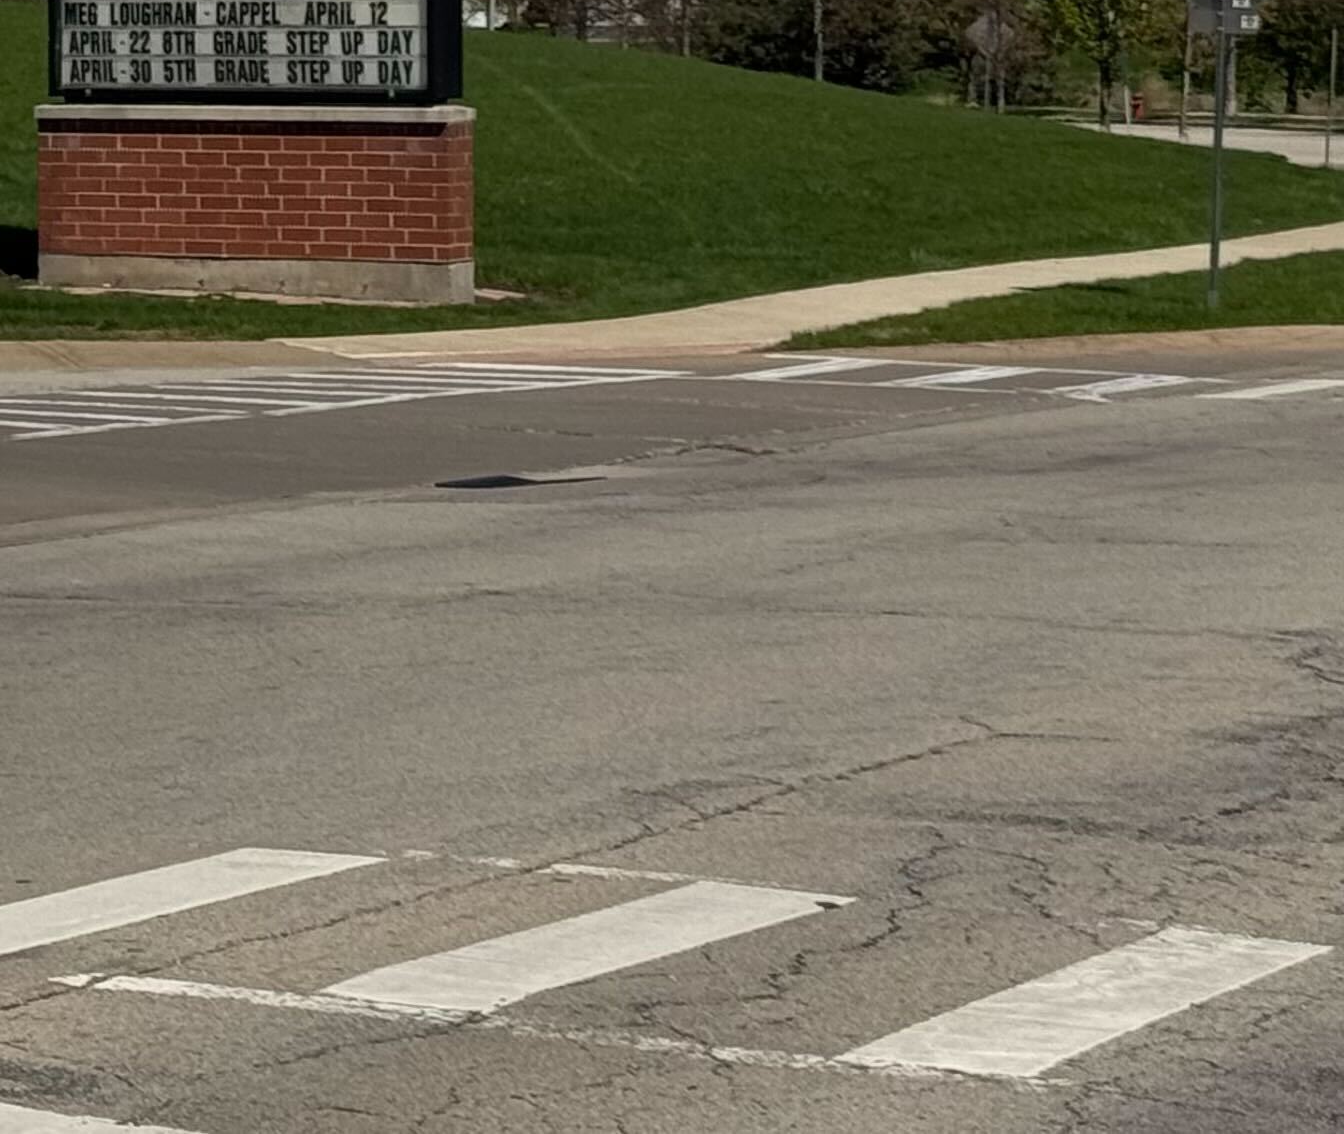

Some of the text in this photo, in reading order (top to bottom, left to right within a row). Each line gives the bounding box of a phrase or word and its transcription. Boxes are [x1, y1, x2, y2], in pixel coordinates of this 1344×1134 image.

[64, 1, 98, 26] MEG
[110, 1, 197, 26] LOUGHRAN
[216, 1, 281, 26] CAPPEL
[304, 1, 355, 26] APRIL
[369, 1, 388, 26] 12
[163, 30, 196, 55] 8TH
[213, 30, 269, 55] GRADE
[286, 30, 330, 55] STEP
[340, 30, 364, 55] UP
[378, 30, 414, 55] DAY
[164, 59, 197, 83] 5TH
[214, 59, 271, 84] GRADE
[287, 59, 331, 84] STEP
[341, 59, 365, 84] UP
[378, 59, 414, 85] DAY
